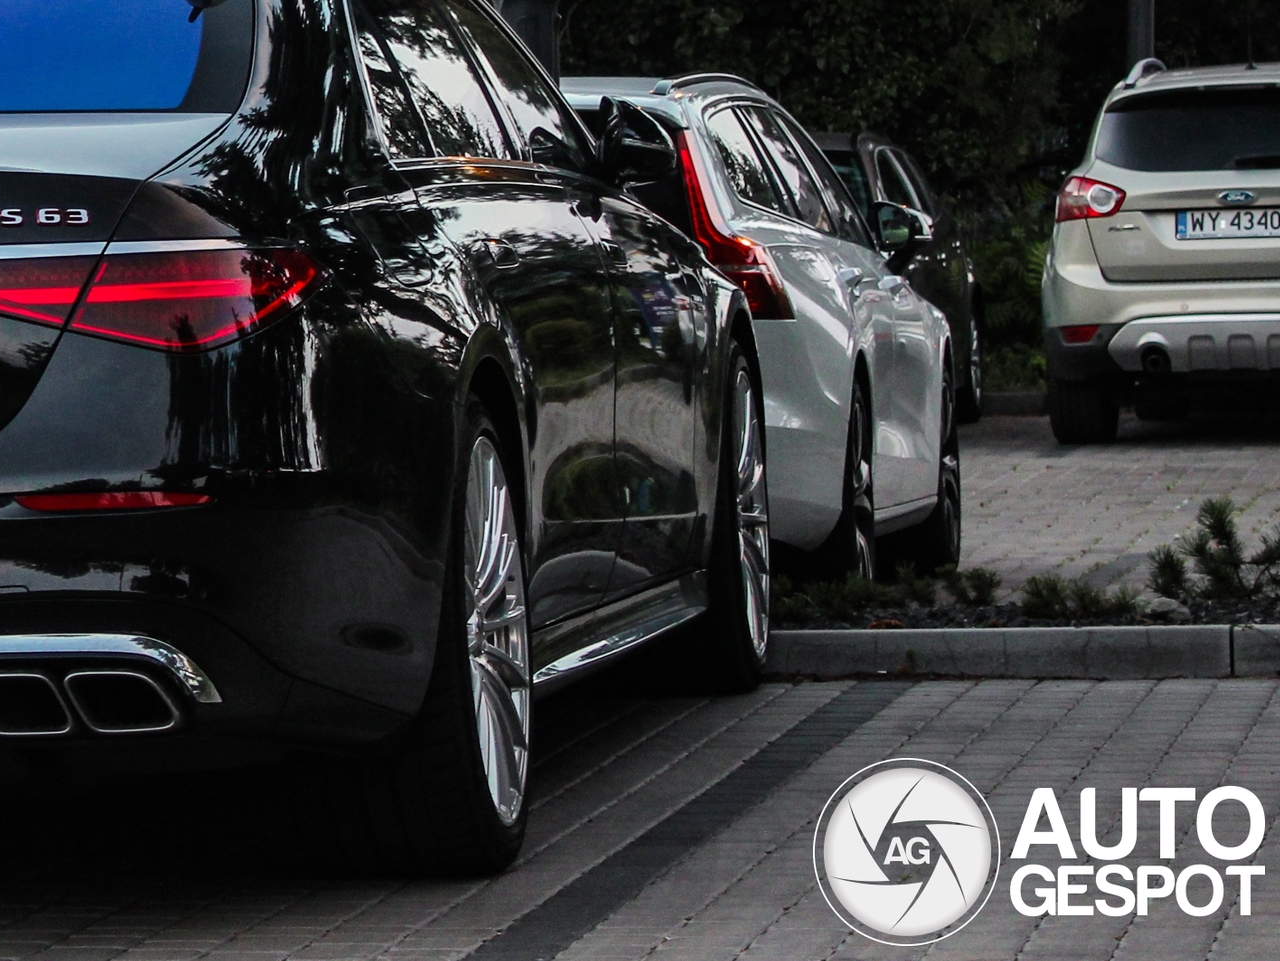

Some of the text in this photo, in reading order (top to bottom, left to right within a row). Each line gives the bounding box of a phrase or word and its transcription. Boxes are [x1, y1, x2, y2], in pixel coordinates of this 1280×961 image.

[0, 208, 89, 225] S 63
[1191, 211, 1280, 231] WY 4340
